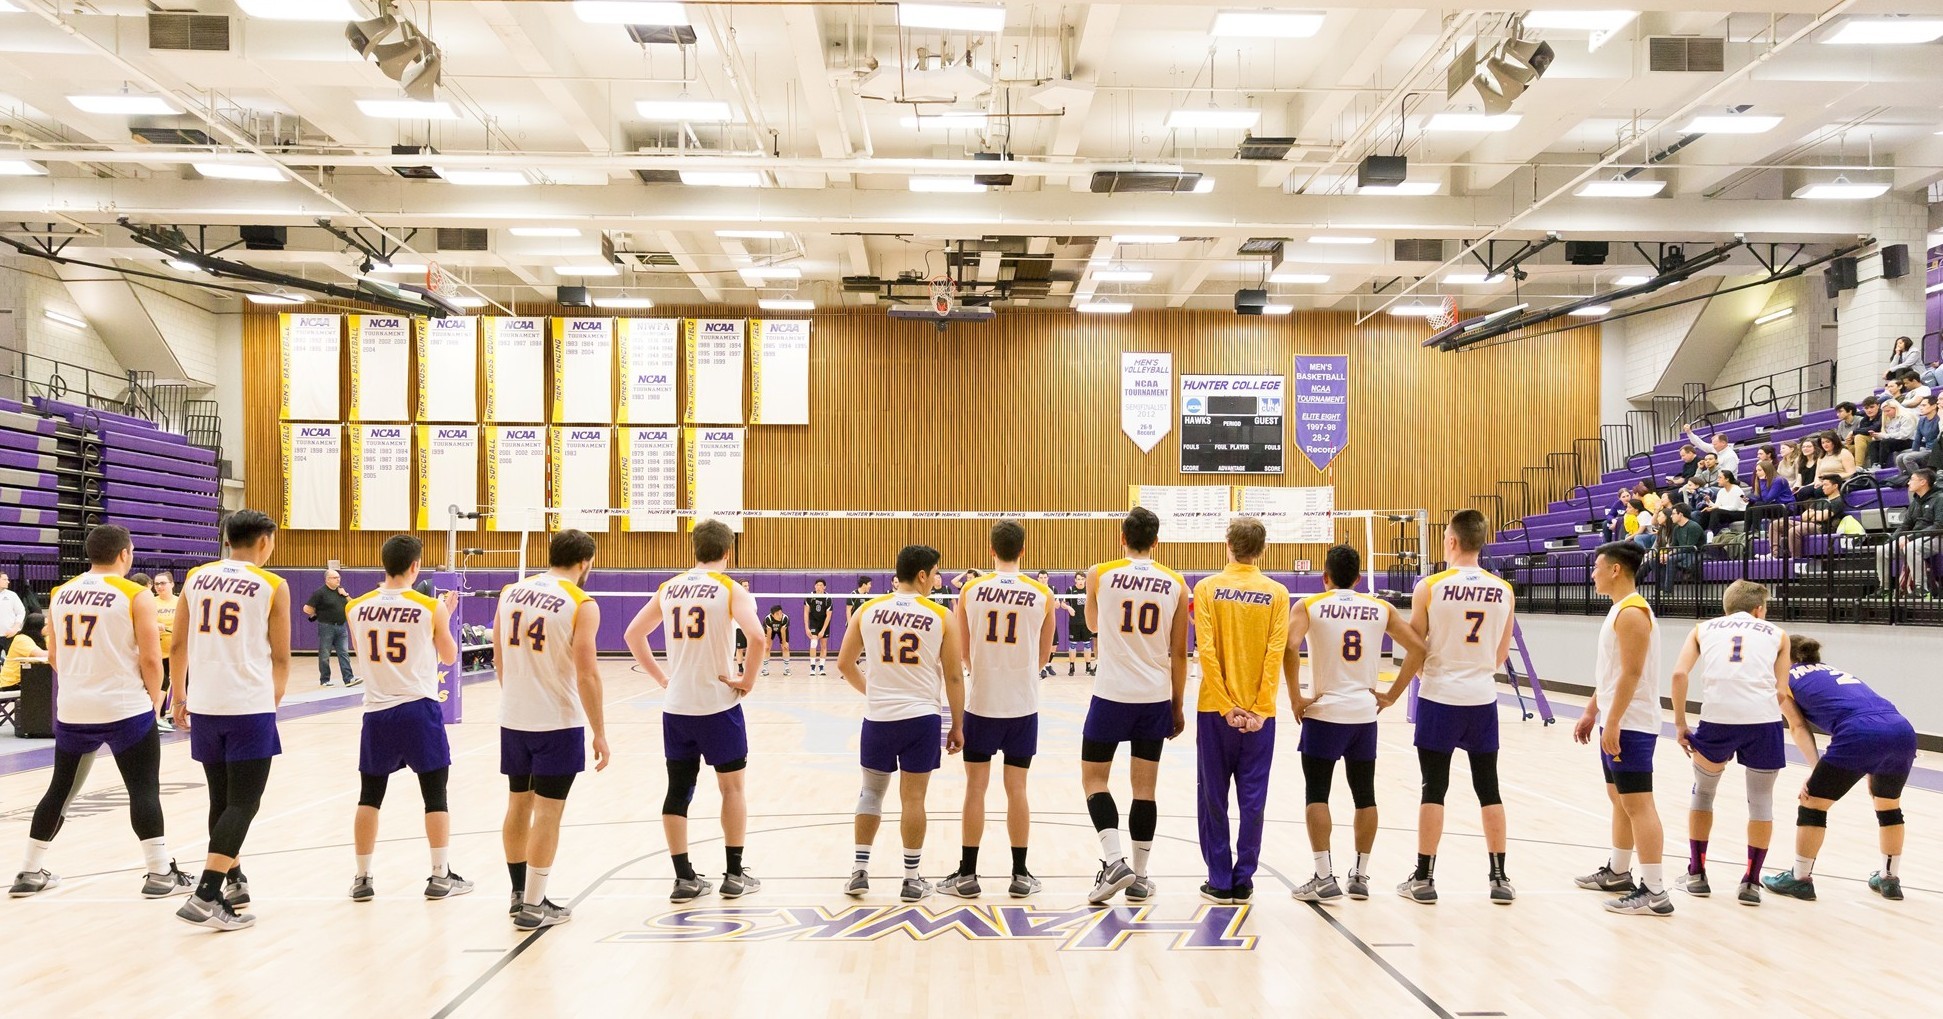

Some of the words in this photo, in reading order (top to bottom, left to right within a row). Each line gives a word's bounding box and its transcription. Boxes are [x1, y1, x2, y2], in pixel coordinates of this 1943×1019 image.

[300, 318, 329, 326] NCAA
[370, 319, 400, 327] NCAA
[437, 320, 466, 328] NCAA
[505, 321, 534, 329] NCAA
[573, 322, 602, 330] NCAA
[770, 324, 799, 332] NCAA
[638, 375, 666, 383] NCAA
[1183, 381, 1228, 389] HUNTER
[1232, 381, 1281, 389] COLLEGE
[1297, 395, 1345, 403] TOURNAMENT
[301, 428, 330, 436] NCAA
[370, 429, 400, 437] NCAA
[438, 430, 467, 438] NCAA
[507, 431, 536, 439] NCAA
[193, 574, 260, 598] HUNTER
[665, 584, 719, 600] HUNTER
[1110, 573, 1172, 595] HUNTER
[1443, 584, 1503, 604] HUNTER
[57, 591, 116, 608] HUNTER
[507, 588, 566, 614] HUNTER
[976, 587, 1036, 608] HUNTER
[1214, 587, 1273, 606] HUNTER
[200, 598, 240, 635] 16
[358, 606, 422, 624] HUNTER
[872, 609, 934, 632] HUNTER
[1120, 600, 1160, 635] 10
[1320, 604, 1379, 621] HUNTER
[63, 614, 98, 648] 17
[508, 610, 546, 652] 14
[671, 606, 706, 640] 13
[985, 610, 1018, 644] 11
[1464, 610, 1485, 644] 7
[1706, 618, 1775, 638] HUNTER
[367, 629, 407, 664] 15
[881, 630, 920, 665] 12
[1342, 630, 1362, 662] 8
[1728, 636, 1744, 663] 1
[600, 903, 1261, 951] HAWKS
